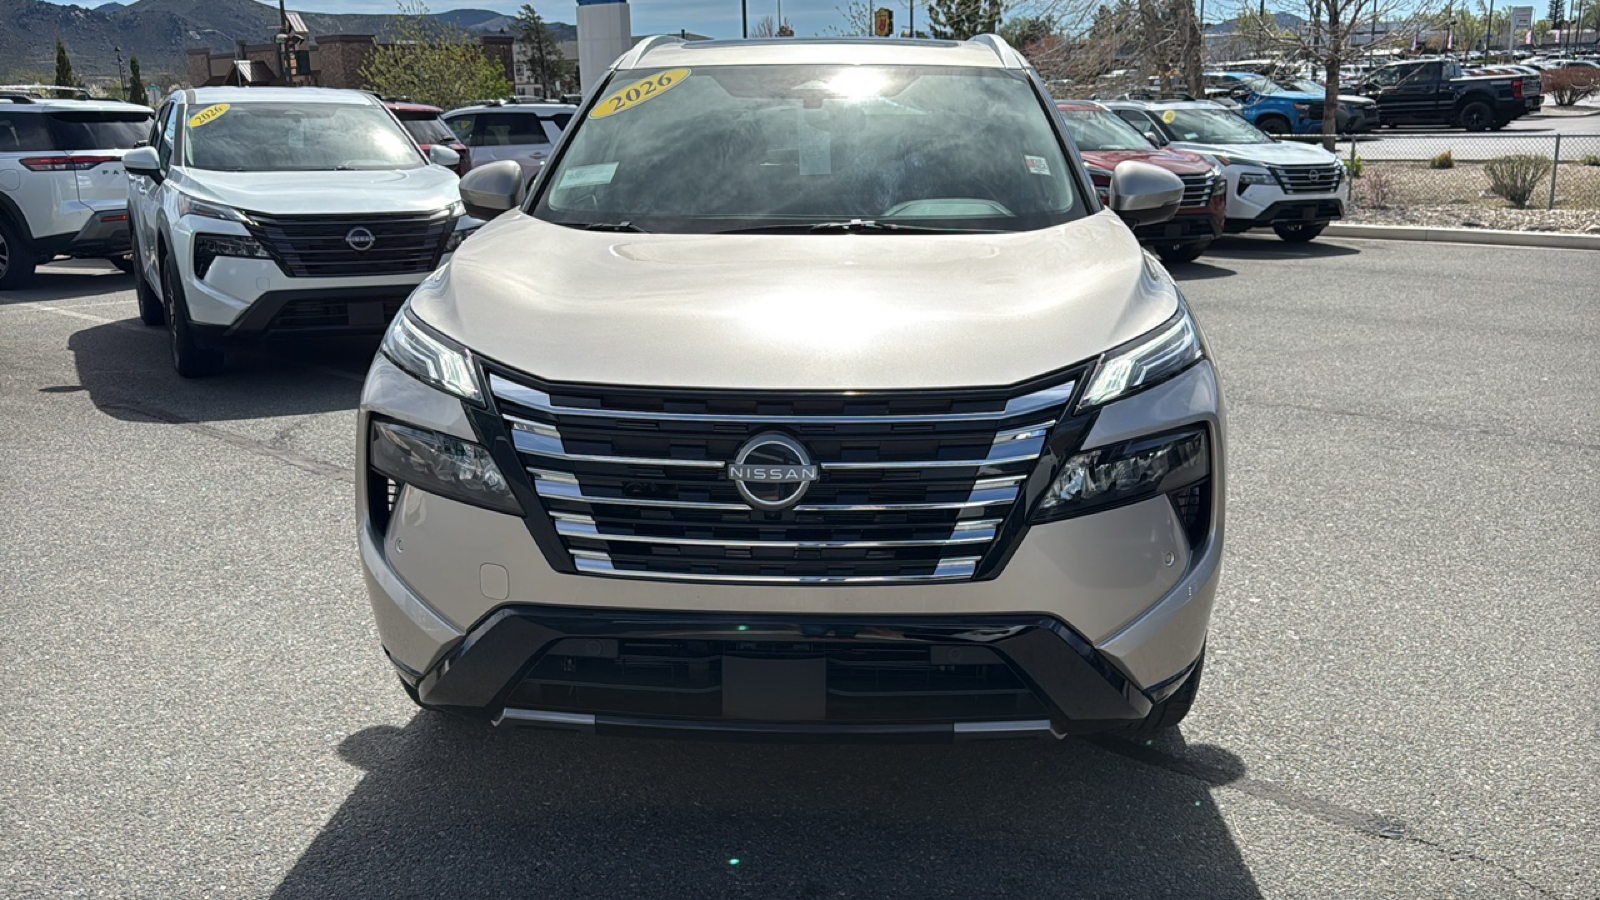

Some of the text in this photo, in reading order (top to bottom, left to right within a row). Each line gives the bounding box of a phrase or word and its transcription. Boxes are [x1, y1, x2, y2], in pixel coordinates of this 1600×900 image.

[609, 73, 672, 112] 2026
[194, 105, 223, 124] 2026
[730, 466, 816, 480] NISSAN
